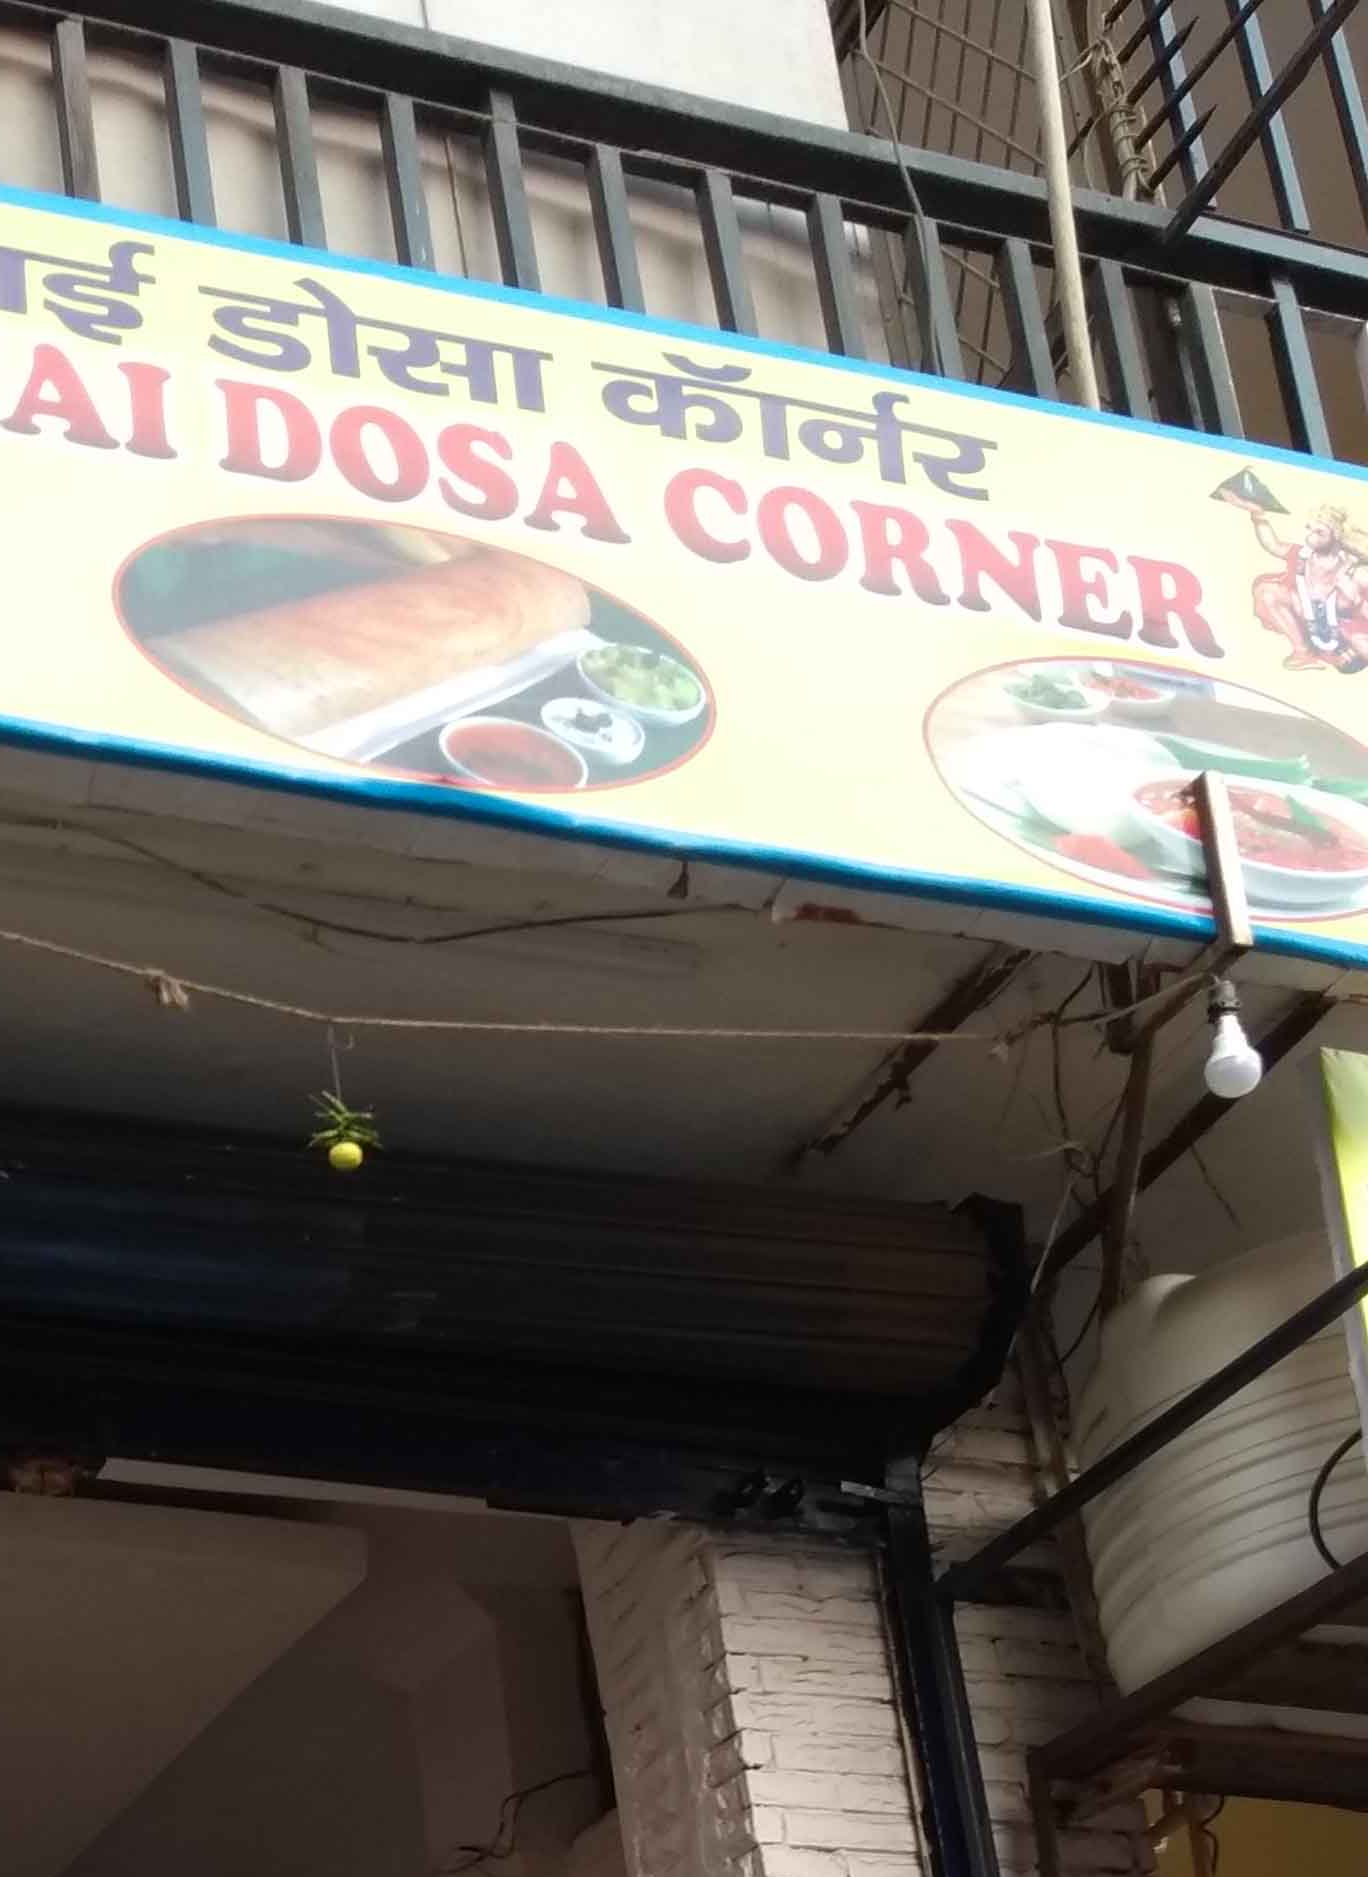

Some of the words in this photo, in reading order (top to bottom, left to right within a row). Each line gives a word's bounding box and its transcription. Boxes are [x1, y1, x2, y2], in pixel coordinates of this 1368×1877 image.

[198, 276, 554, 414] डोसा
[590, 351, 999, 502] कॉर्नर
[214, 378, 632, 545] DOSA
[663, 467, 1225, 659] CORNER
